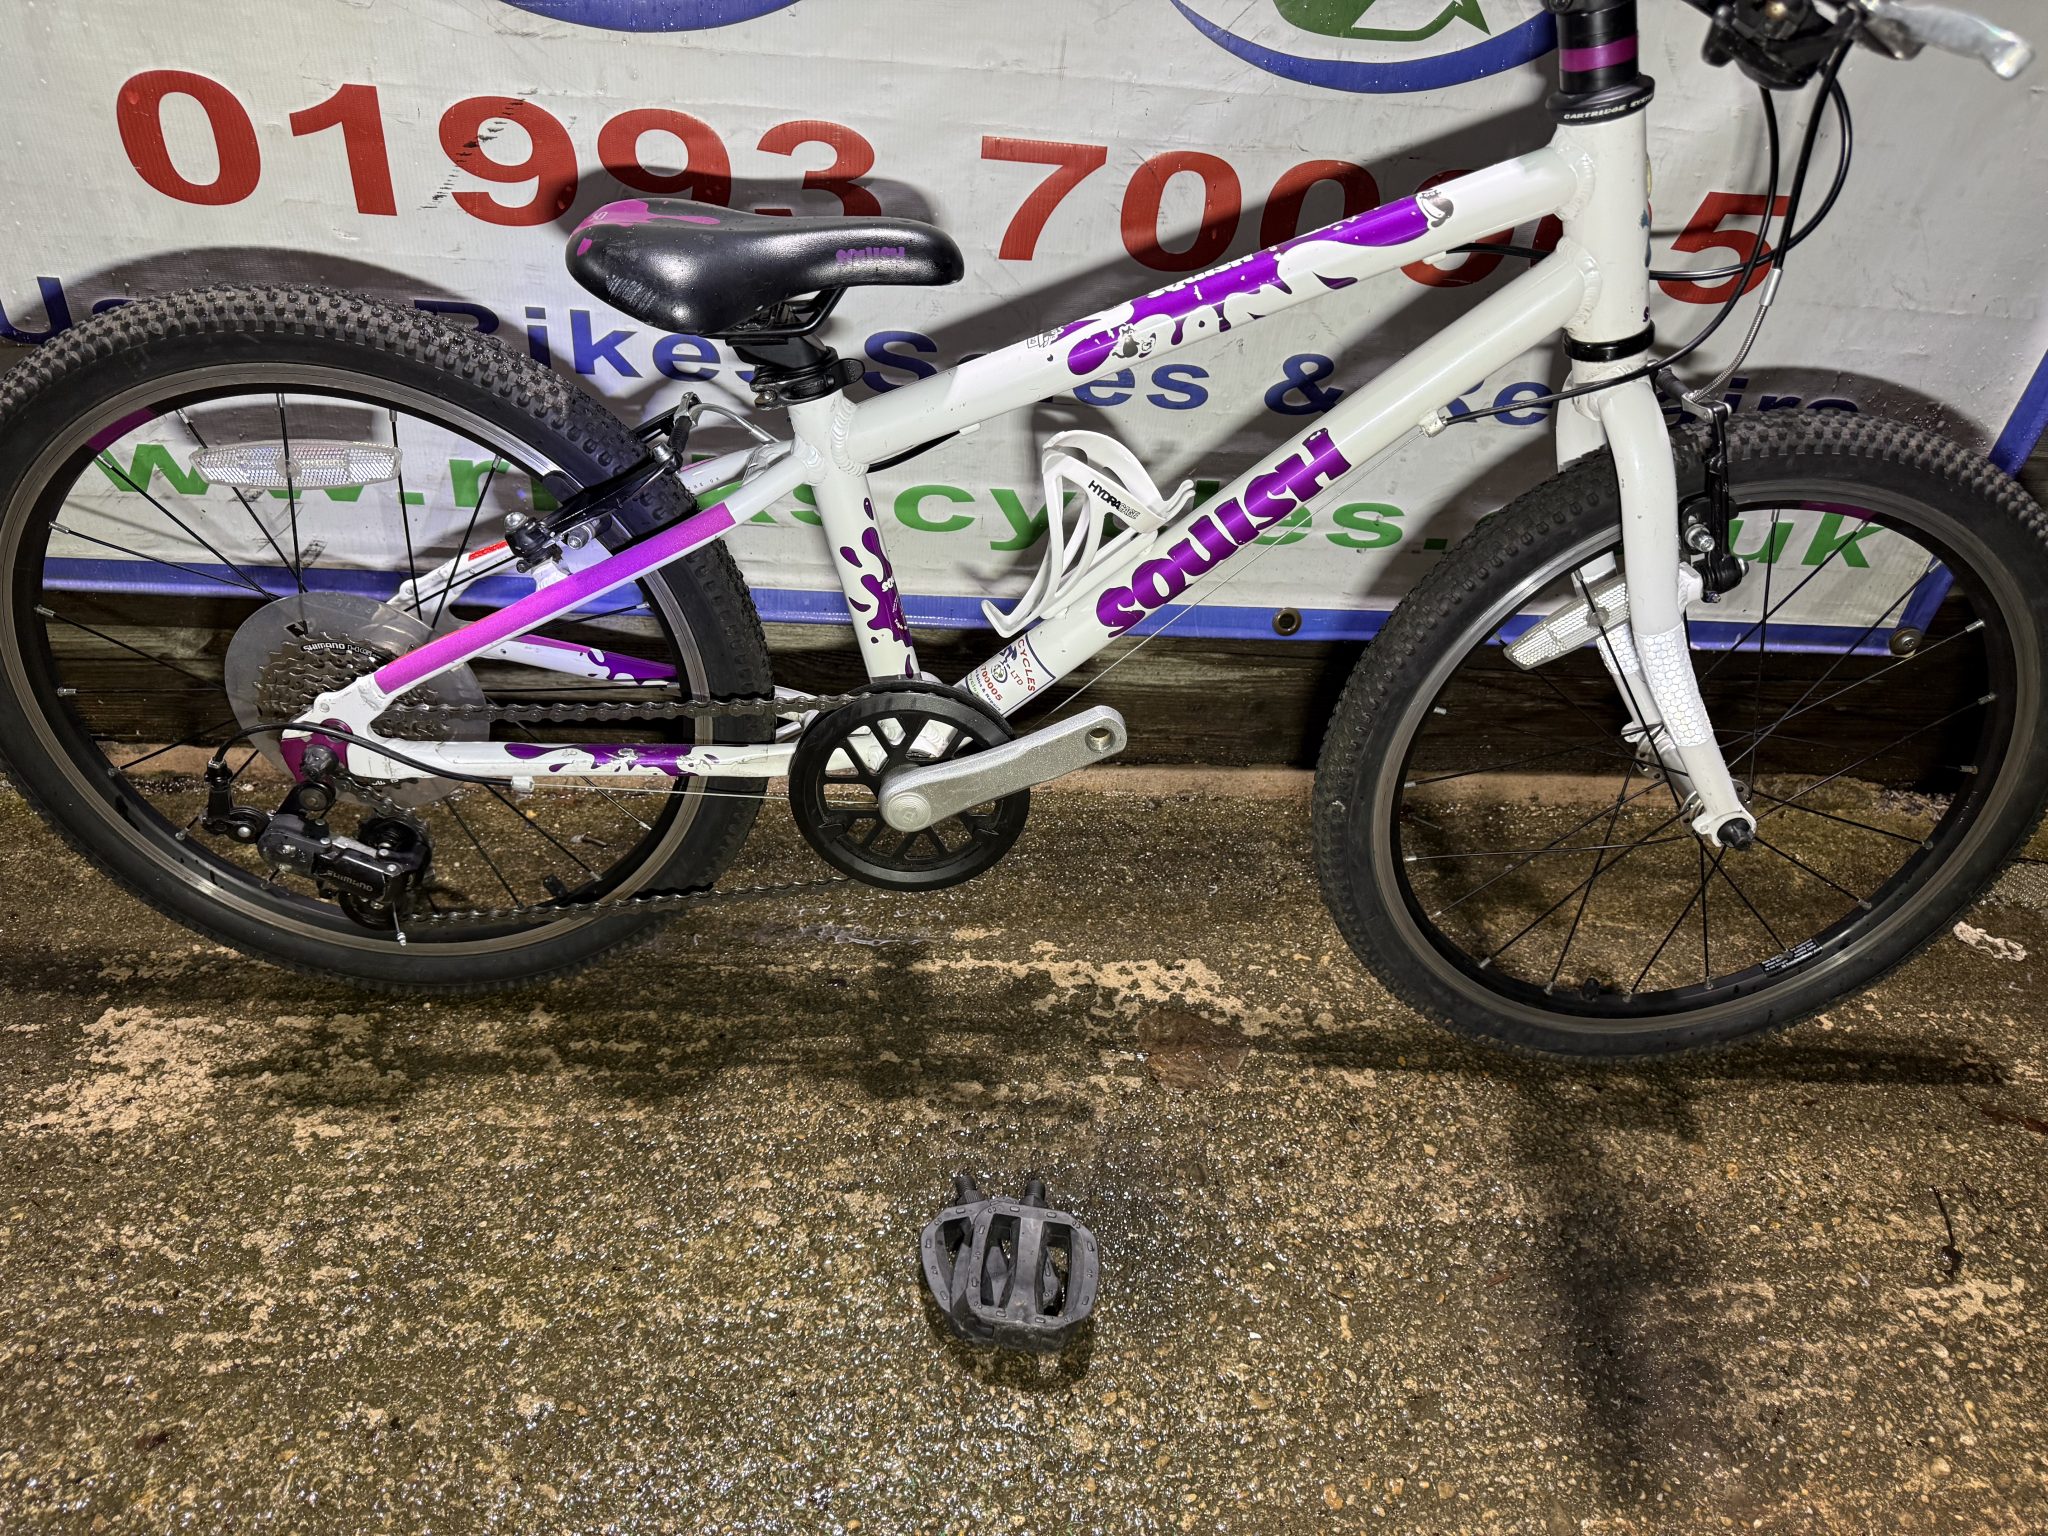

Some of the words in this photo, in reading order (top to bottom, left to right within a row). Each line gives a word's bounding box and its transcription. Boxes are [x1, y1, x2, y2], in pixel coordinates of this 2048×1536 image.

[1563, 105, 1626, 119] CARTRIDGE
[117, 70, 882, 227] 01993
[1264, 353, 1344, 415] &
[1096, 428, 1352, 638] SQUISH
[303, 641, 345, 651] SHIMANO
[1017, 638, 1036, 692] CYCLES
[1010, 670, 1024, 686] LTD
